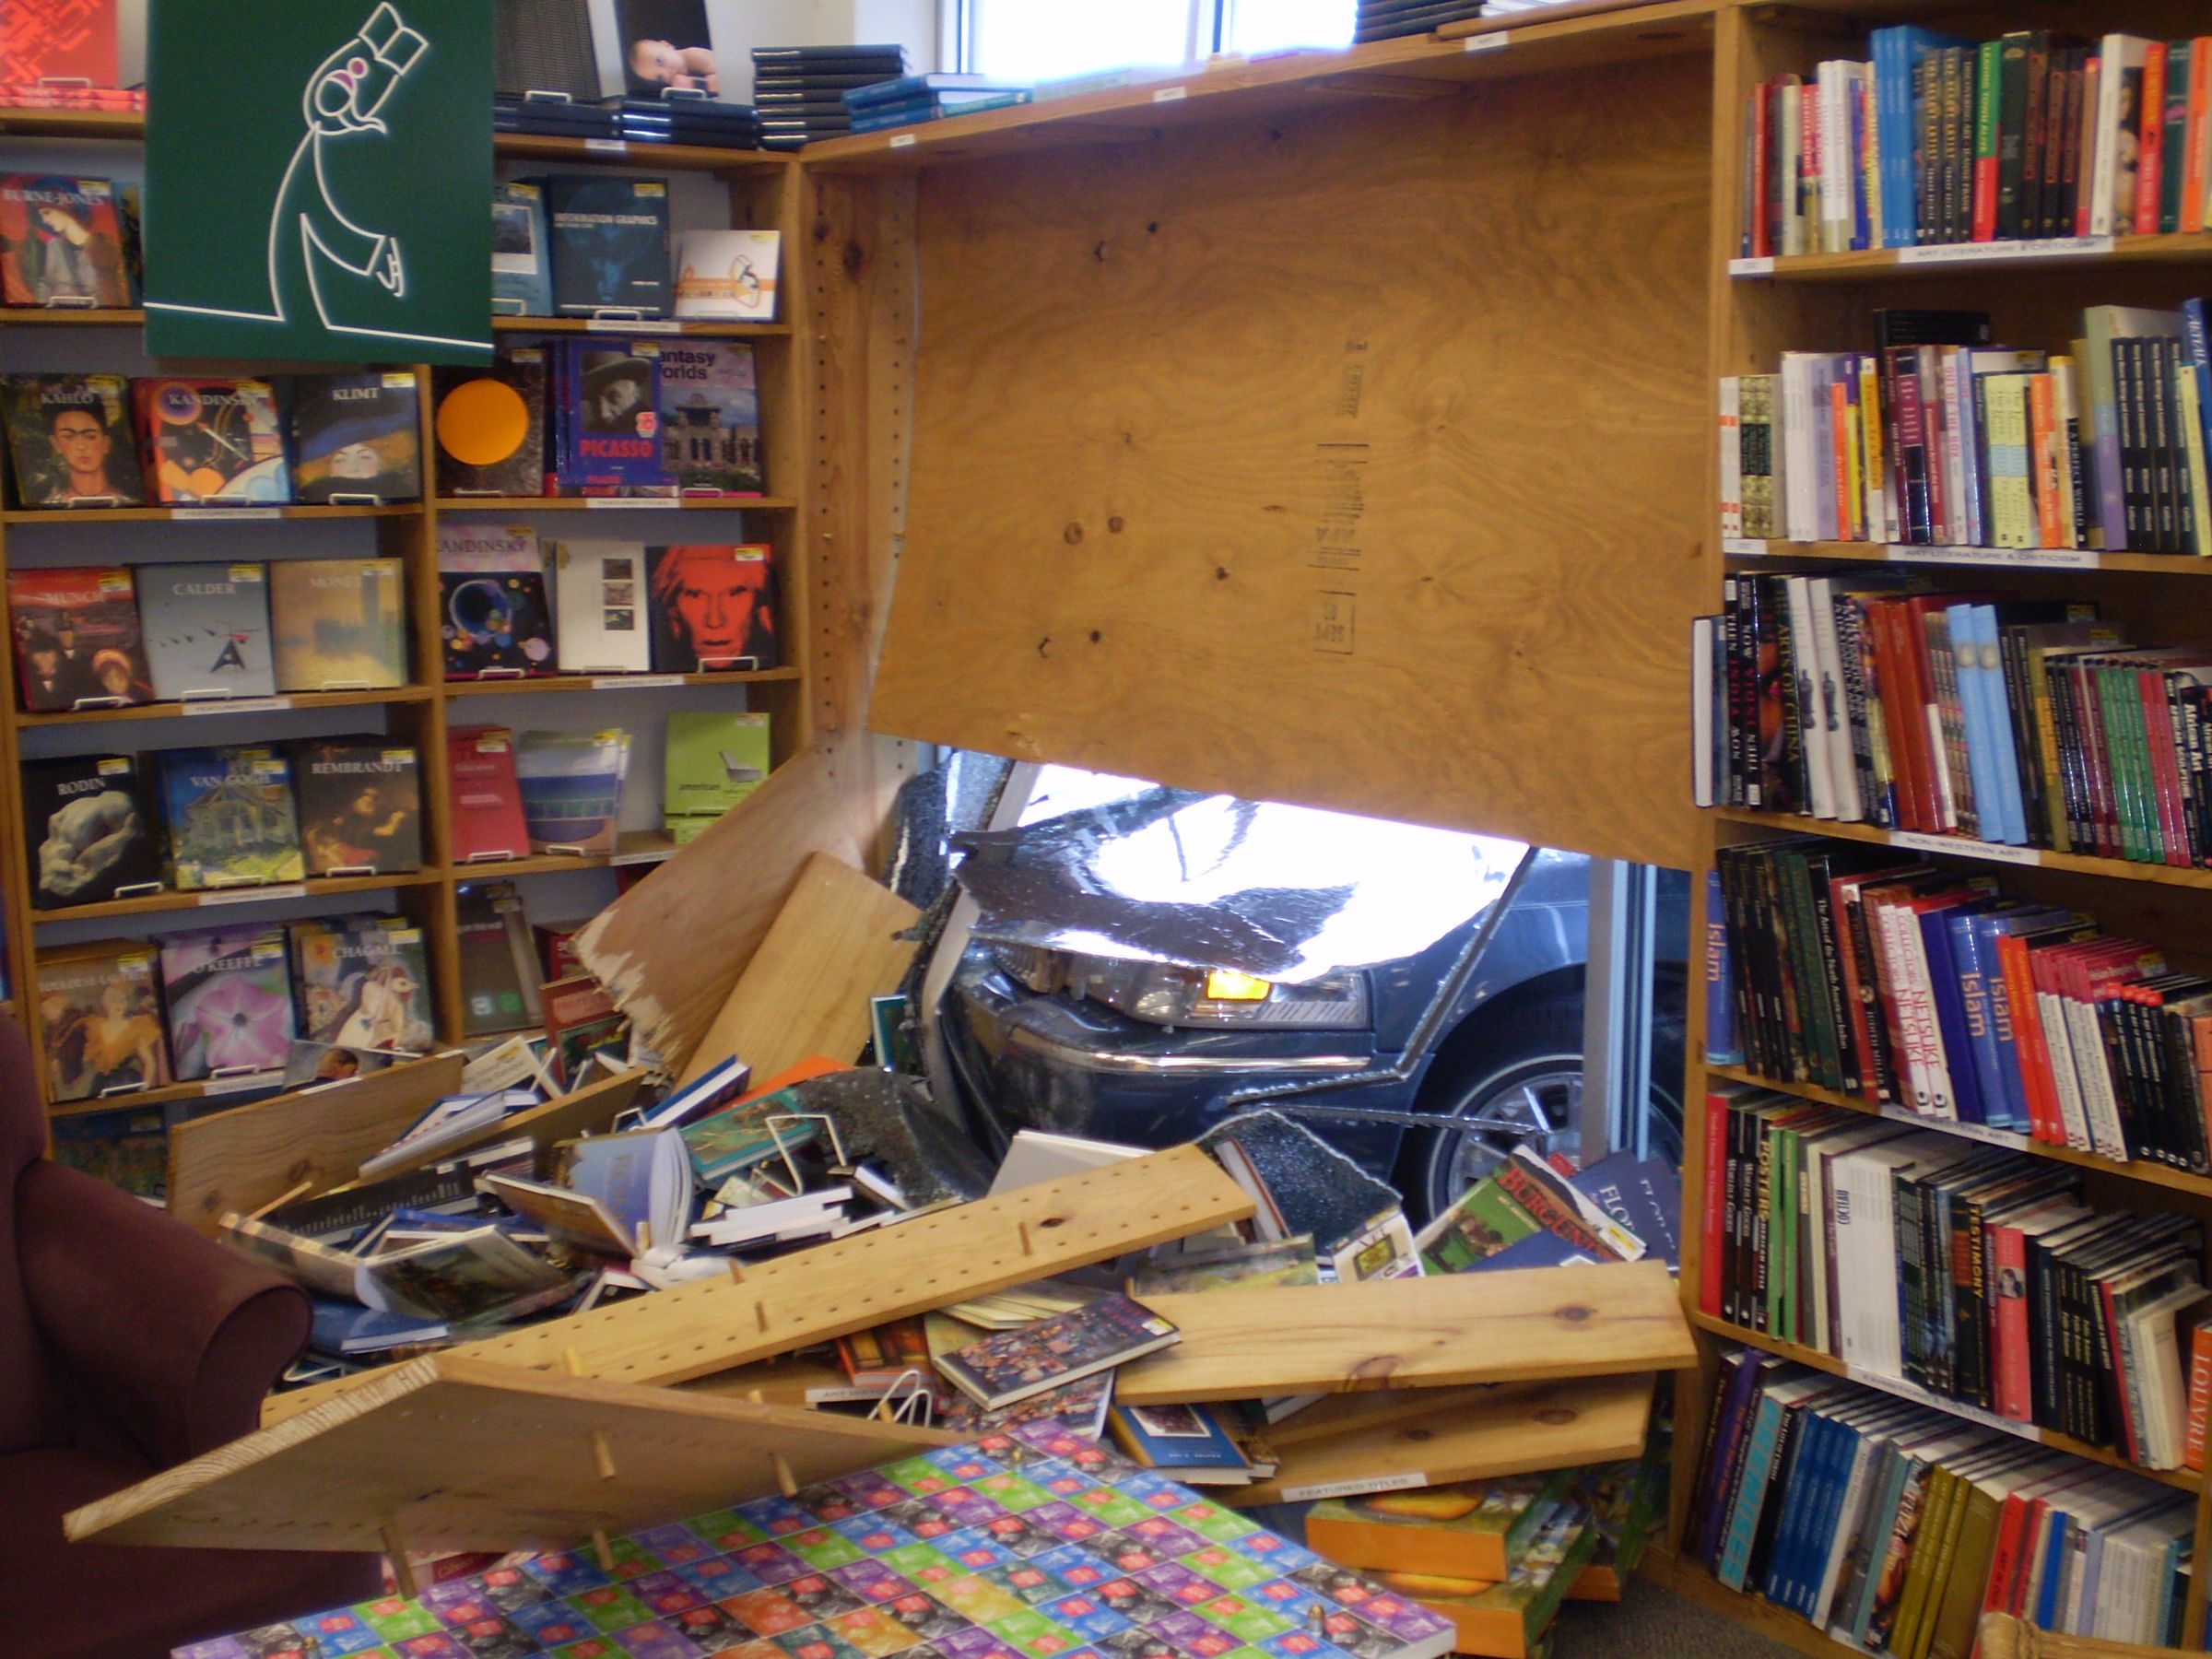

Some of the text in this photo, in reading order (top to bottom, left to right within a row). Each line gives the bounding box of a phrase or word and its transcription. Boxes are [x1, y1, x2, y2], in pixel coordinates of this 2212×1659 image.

[658, 349, 715, 367] antasy
[661, 363, 708, 380] orlds
[332, 387, 379, 402] KLIMT
[579, 439, 654, 458] PICASSO
[172, 582, 237, 597] CALDER
[1783, 701, 1800, 762] CHINA
[2183, 702, 2204, 771] African Art
[56, 776, 107, 797] RODIN
[1706, 922, 1725, 982] Islam
[1894, 987, 1923, 1070] NETSUKE
[1911, 988, 1940, 1071] NETSUKE
[1960, 971, 1990, 1038] Islam
[1989, 975, 2014, 1042] Islam
[1758, 1139, 1770, 1219] POSTERS
[1835, 1189, 1850, 1225] COCTEAU
[1969, 1207, 1983, 1299] TESTIMONY
[2188, 1354, 2211, 1452] LOUVRE
[1299, 1477, 1409, 1497] FEATURED TITLES
[1719, 1397, 1781, 1583] PREMISES
